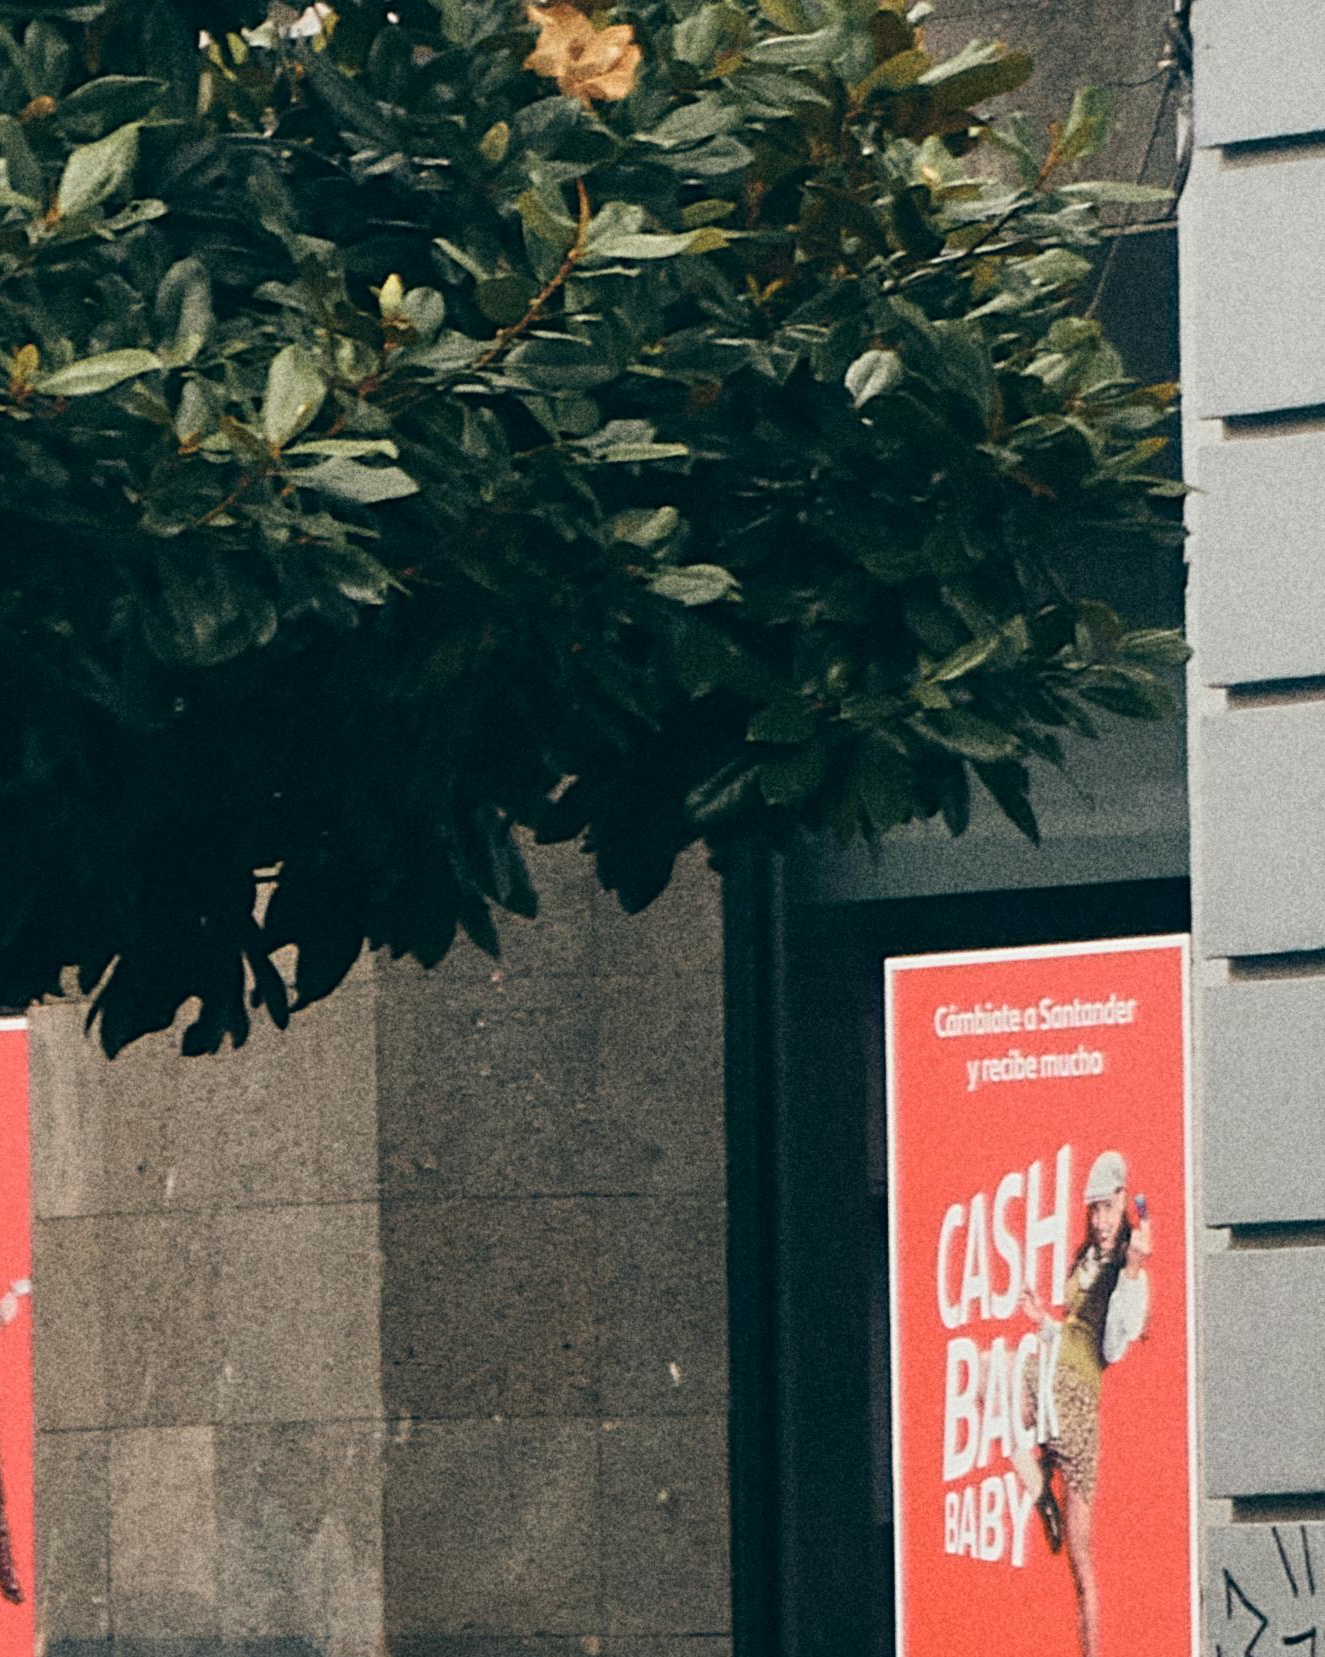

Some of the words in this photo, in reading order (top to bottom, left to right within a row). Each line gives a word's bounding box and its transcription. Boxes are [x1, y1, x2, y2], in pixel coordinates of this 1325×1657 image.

[1023, 1006, 1037, 1030] a
[1038, 994, 1137, 1030] Santander
[966, 1060, 979, 1092] y
[980, 1049, 1038, 1082] recibe
[1039, 1044, 1104, 1077] mucho
[937, 1143, 1072, 1329] CASH
[943, 1327, 1062, 1481] BACK
[944, 1473, 1034, 1568] BABY
